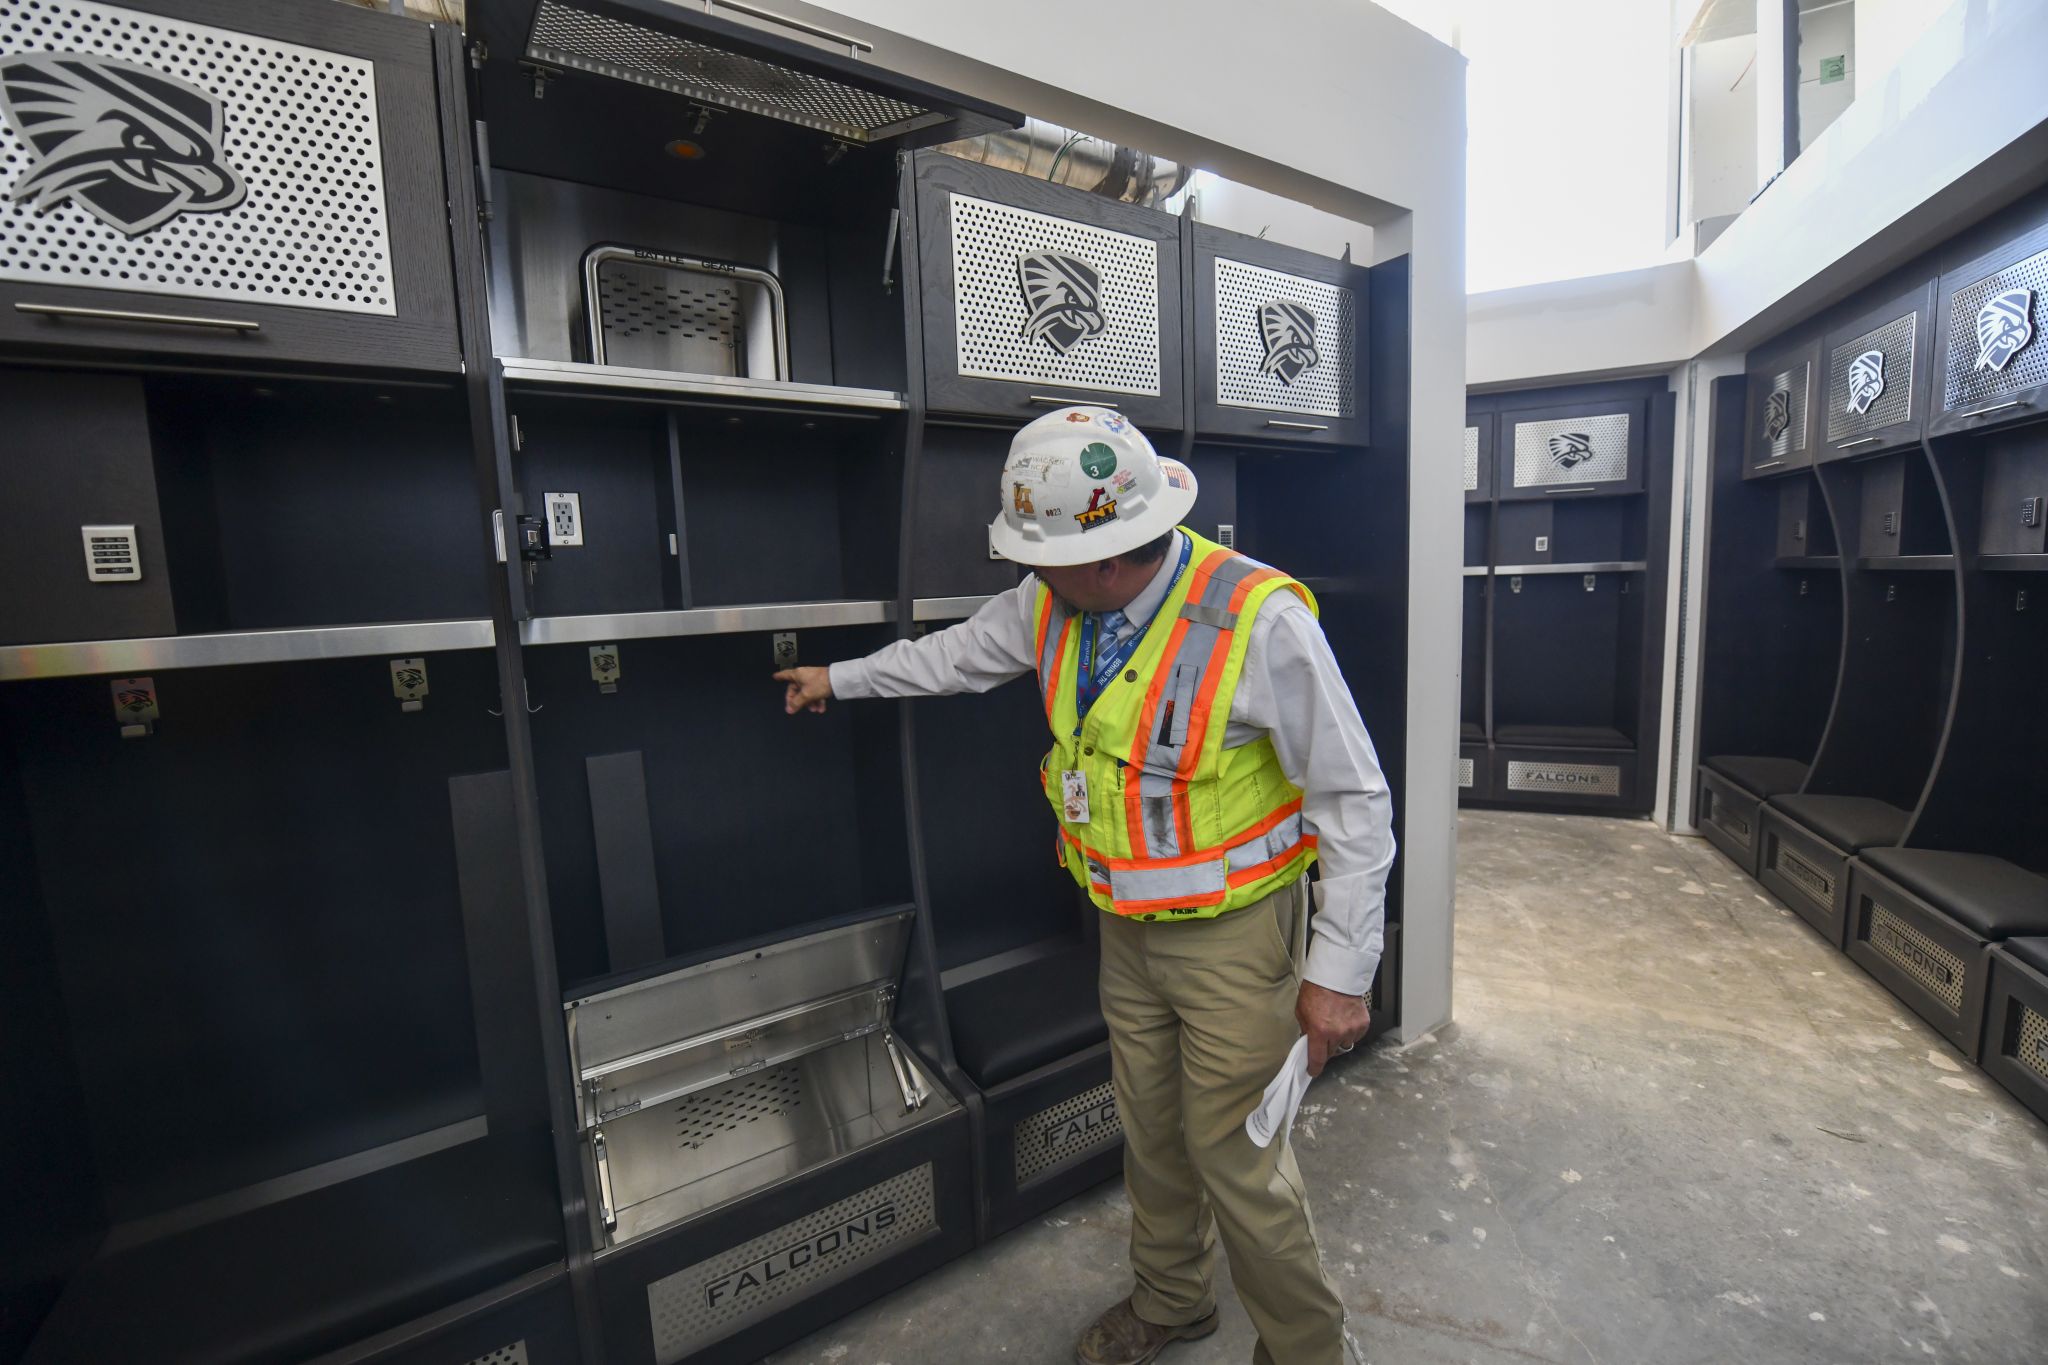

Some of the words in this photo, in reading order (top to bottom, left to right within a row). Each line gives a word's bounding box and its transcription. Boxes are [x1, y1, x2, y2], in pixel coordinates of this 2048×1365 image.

[634, 249, 684, 265] BATTLE
[701, 260, 736, 273] GEAR
[1090, 465, 1100, 477] 3
[1074, 499, 1118, 526] TNT
[1104, 657, 1123, 678] BEHIND
[1097, 676, 1109, 686] THE
[1526, 772, 1601, 784] FALCONS
[1168, 907, 1198, 916] VIKING
[1876, 922, 1946, 983] FALCONS
[1049, 1103, 1116, 1148] FALC
[707, 1205, 896, 1309] FALCONS
